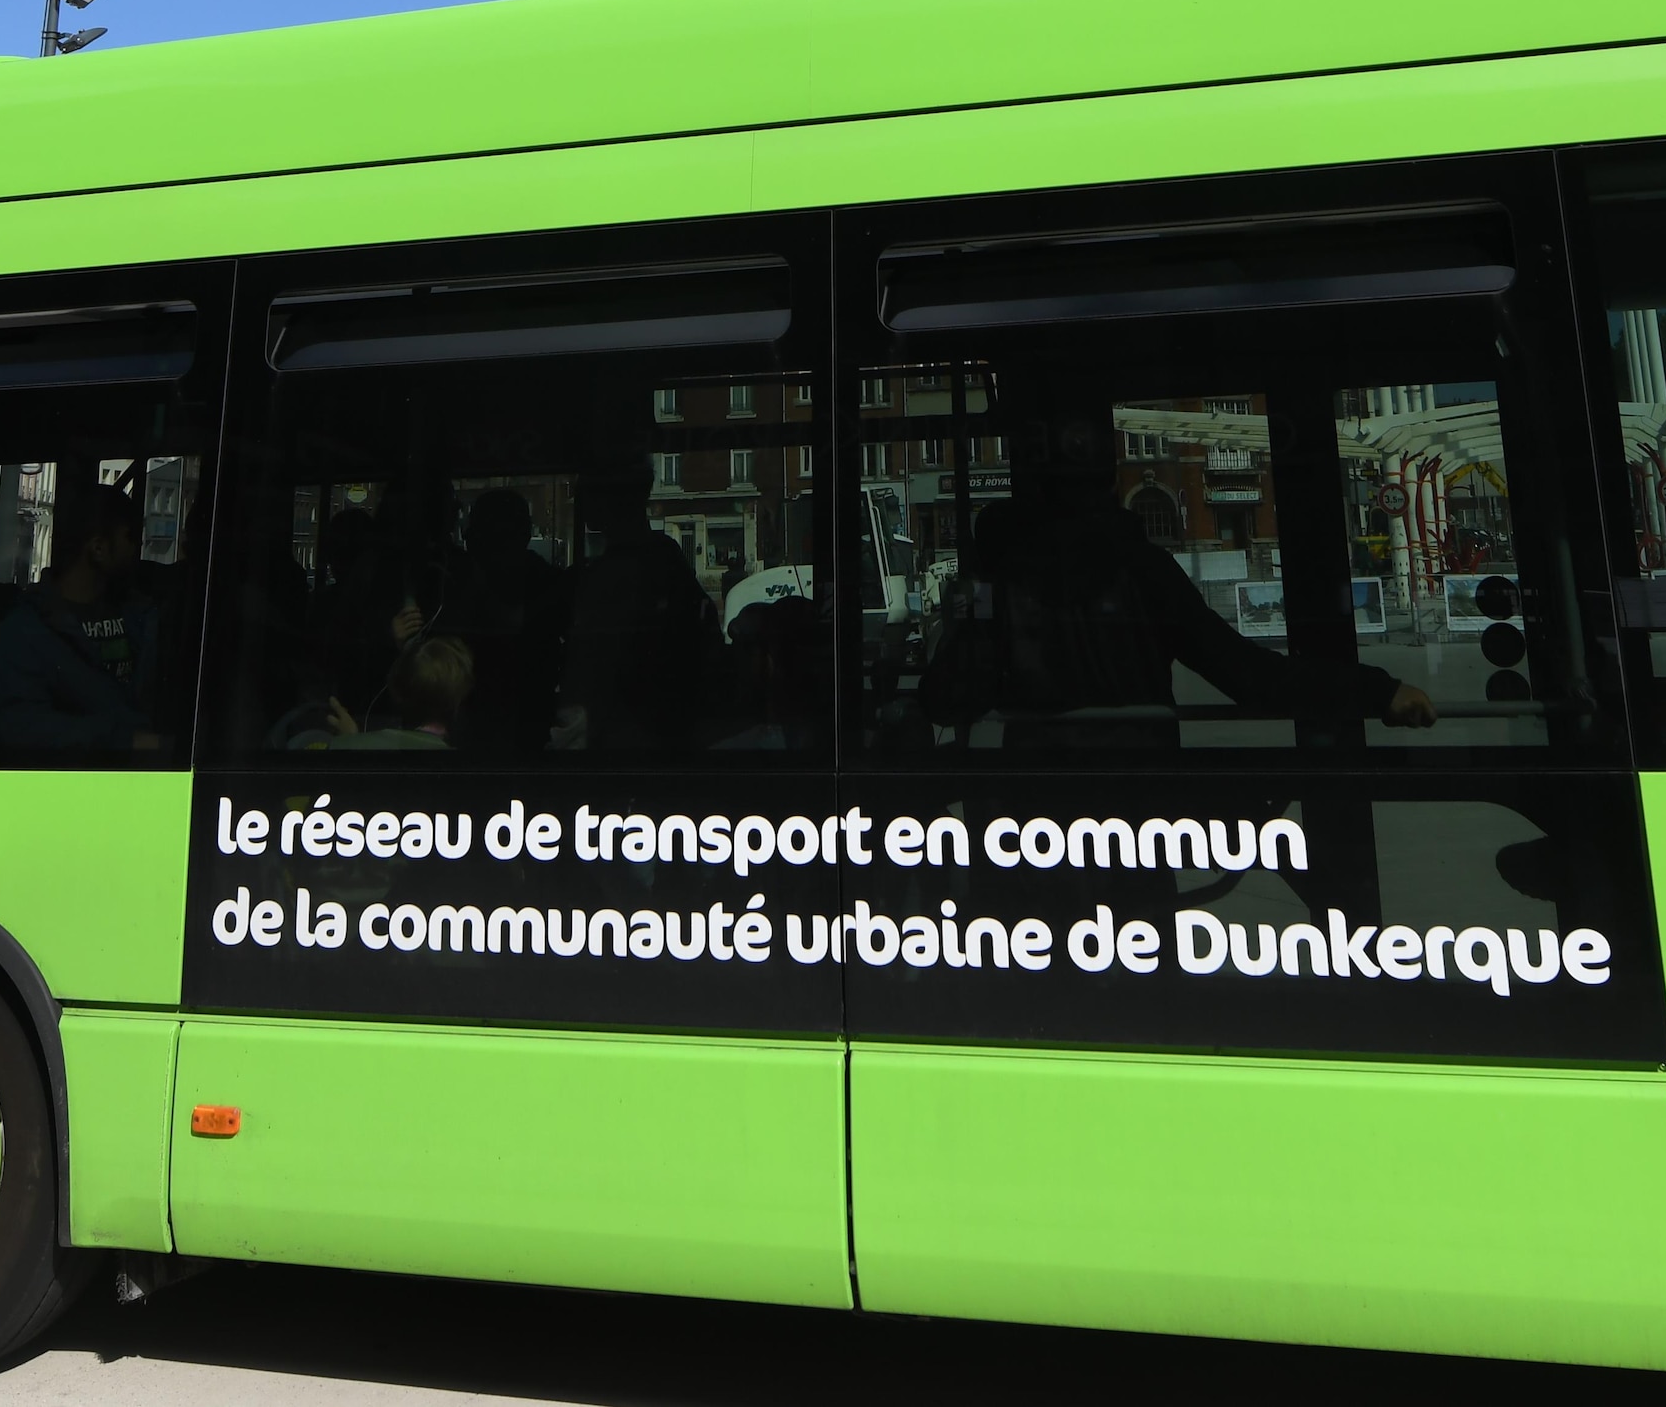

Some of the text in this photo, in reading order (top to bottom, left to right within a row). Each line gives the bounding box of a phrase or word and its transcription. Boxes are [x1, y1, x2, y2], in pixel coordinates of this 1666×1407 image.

[218, 793, 1307, 876] le réseau de transport en commun
[213, 887, 1610, 997] de la communauté urbaine de Dunkerque
